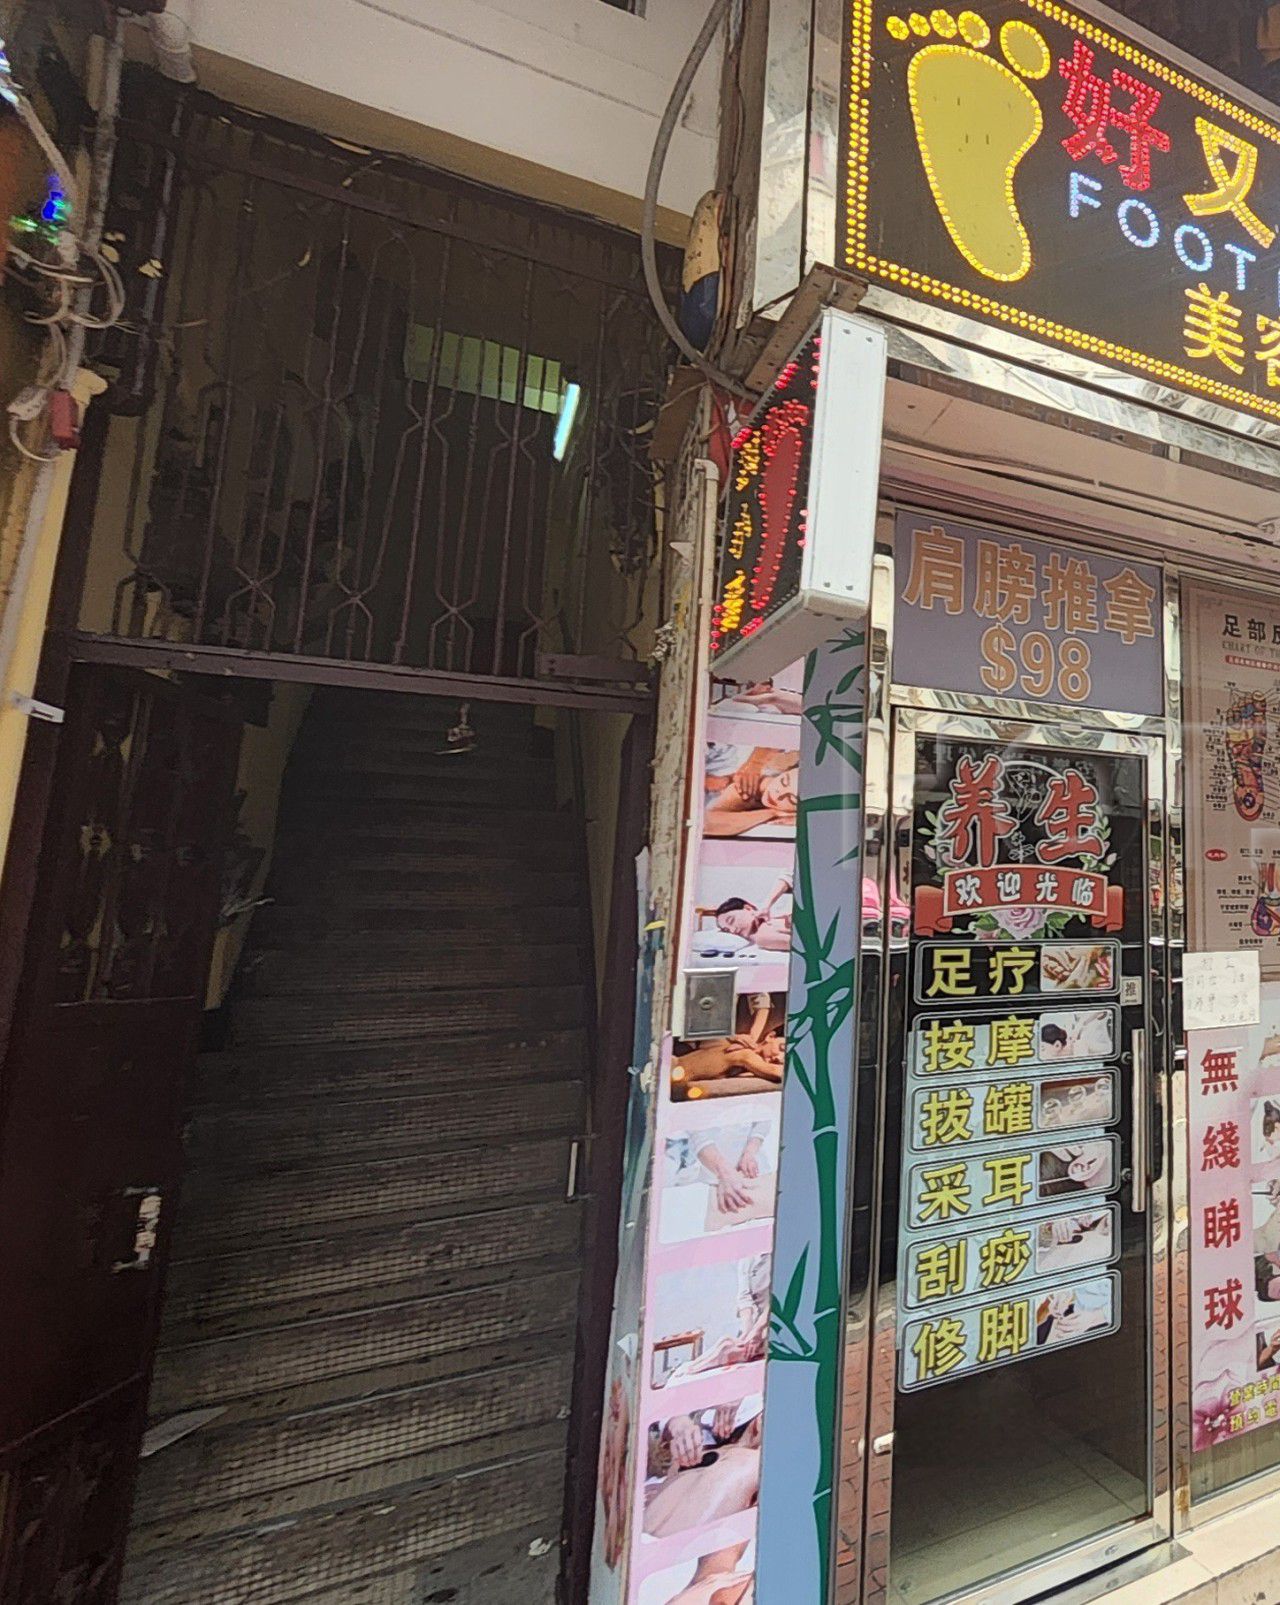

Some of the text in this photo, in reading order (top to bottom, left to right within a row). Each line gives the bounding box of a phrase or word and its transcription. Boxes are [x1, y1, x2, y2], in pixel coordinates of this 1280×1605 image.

[1068, 170, 1256, 291] FOOT
[902, 525, 1156, 645] 肩膀推拿
[980, 622, 1092, 702] $98
[942, 753, 1105, 869] 养生
[954, 871, 1097, 907] 欢迎光临
[926, 946, 1037, 998] 足疗
[922, 1014, 1036, 1073] 按摩
[920, 1081, 1034, 1146] 拔罐
[918, 1153, 1033, 1224] 采耳
[1200, 1048, 1243, 1331] 無綫睇球
[916, 1228, 1033, 1301] 刮痧
[913, 1299, 1030, 1382] 修脚
